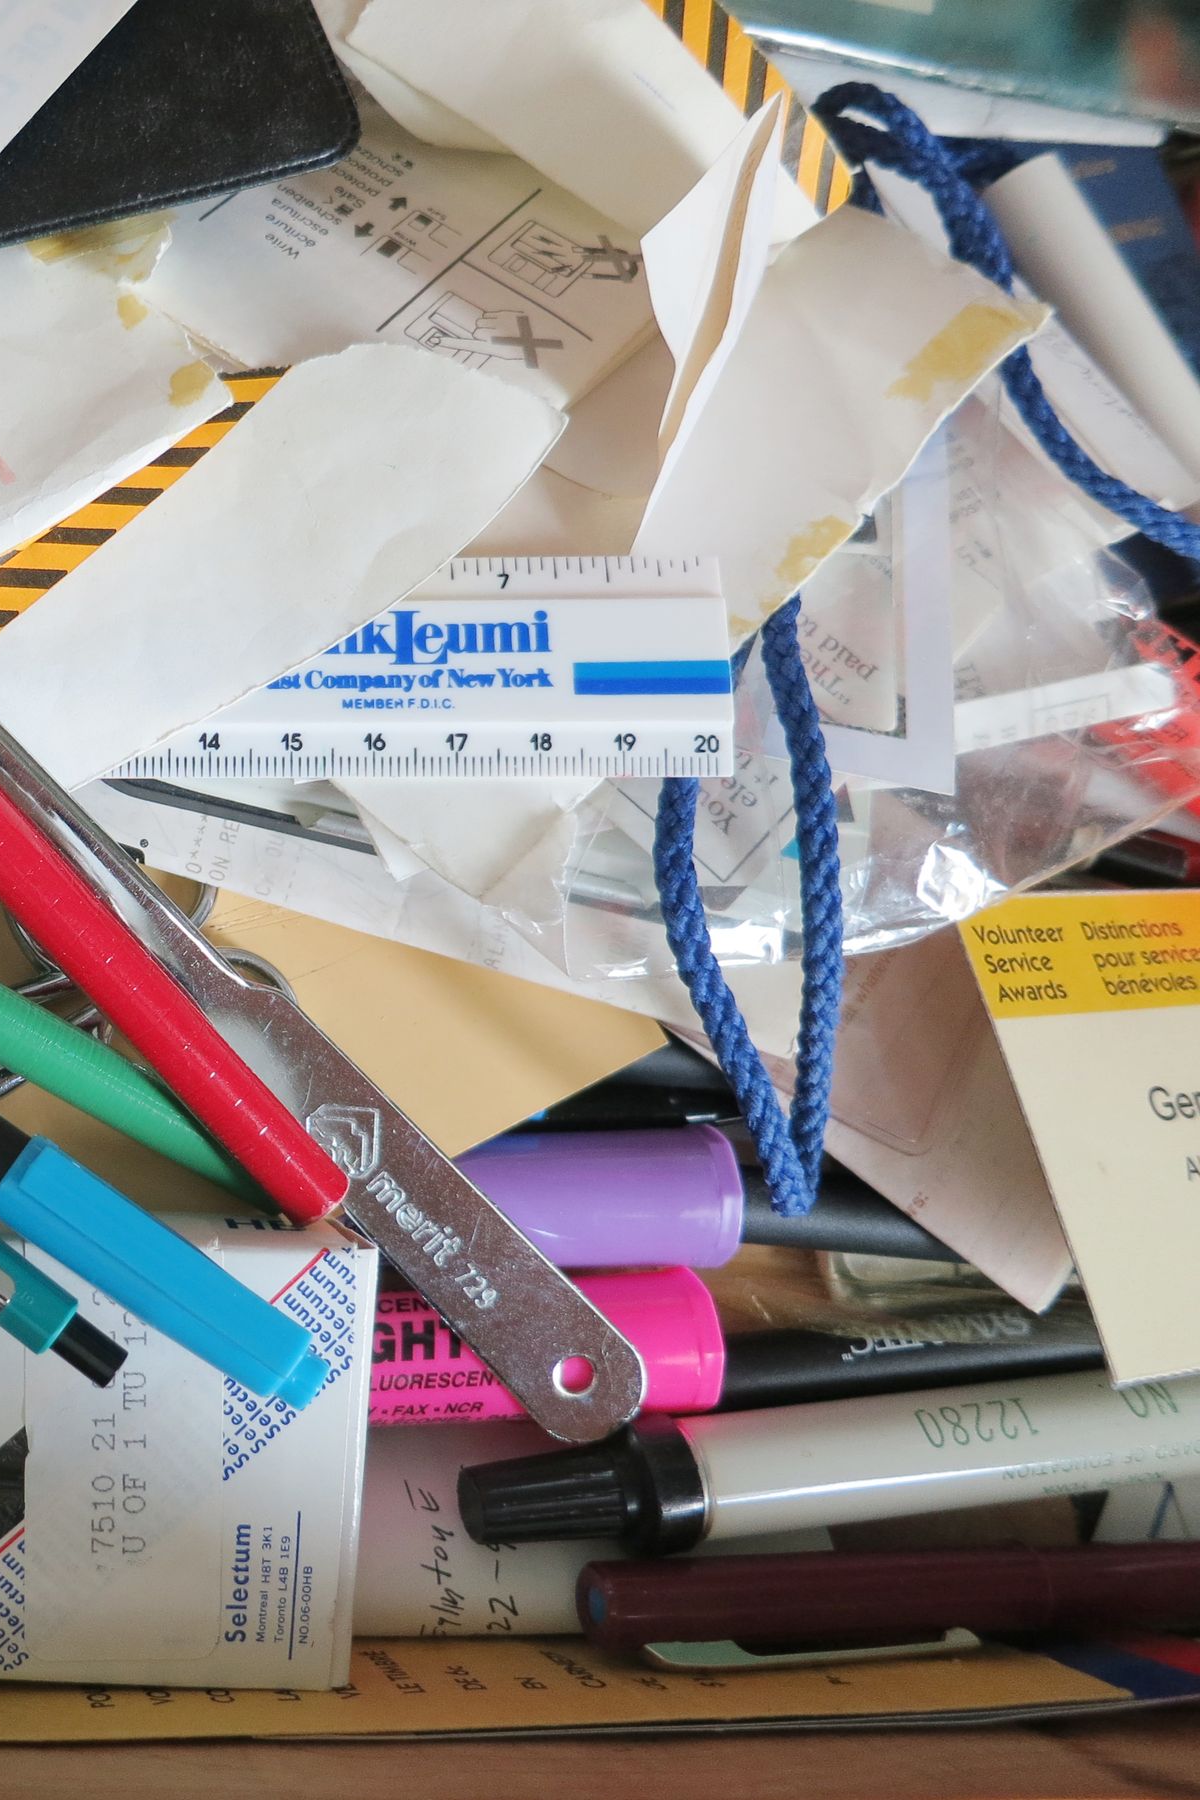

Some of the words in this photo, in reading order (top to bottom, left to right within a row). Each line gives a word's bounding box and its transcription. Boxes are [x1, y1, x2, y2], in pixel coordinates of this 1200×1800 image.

[277, 184, 343, 226] schreiben
[334, 185, 367, 210] Safe
[271, 197, 330, 237] escritura
[264, 232, 301, 261] Write
[497, 573, 510, 590] 7
[819, 634, 880, 681] paid
[304, 669, 415, 693] Company
[421, 669, 445, 688] of
[447, 669, 495, 689] New
[498, 668, 554, 688] York
[199, 733, 221, 752] 14
[281, 733, 303, 752] 15
[364, 733, 386, 752] 16
[446, 733, 468, 752] 17
[531, 733, 553, 752] 18
[614, 734, 636, 753] 19
[695, 734, 720, 753] 20
[972, 925, 1064, 945] Volunteer
[1080, 920, 1183, 942] Distinctions
[985, 953, 1054, 974] Service
[1093, 952, 1136, 972] pour
[999, 982, 1068, 1003] Awards
[1102, 973, 1198, 996] bénévoles
[366, 1170, 464, 1269] merit
[455, 1260, 497, 1309] 729
[283, 1293, 353, 1371] Selectum
[123, 1371, 146, 1411] TU
[392, 1404, 428, 1416] FAX
[443, 1401, 484, 1413] NCR
[92, 1413, 115, 1452] 21
[914, 1397, 1039, 1448] 12280
[123, 1473, 146, 1514] OF
[92, 1474, 115, 1555] 7510
[123, 1535, 146, 1556] U
[262, 1526, 272, 1550] 3K1
[280, 1535, 291, 1559] 1E9
[225, 1524, 251, 1642] Selectum
[261, 1558, 271, 1583] H8T
[278, 1566, 289, 1592] L4B
[256, 1590, 268, 1642] Montreal
[274, 1597, 287, 1643] Toronto
